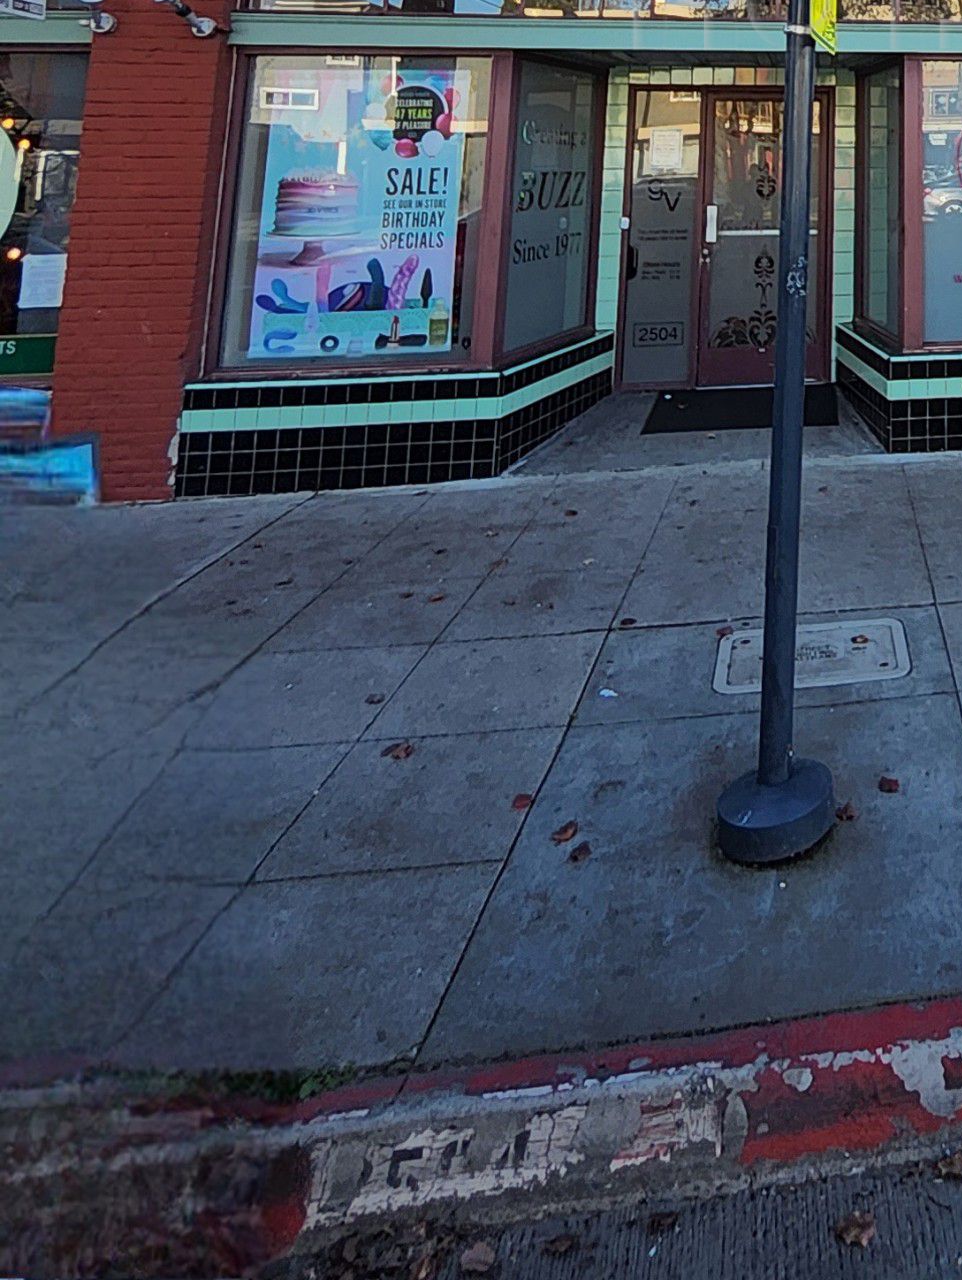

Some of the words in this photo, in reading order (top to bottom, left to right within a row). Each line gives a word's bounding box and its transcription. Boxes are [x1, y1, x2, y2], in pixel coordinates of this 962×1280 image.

[407, 108, 432, 119] YEARS
[386, 167, 448, 195] SALE!
[515, 171, 586, 213] BUZZ
[383, 200, 396, 209] SEE
[399, 200, 412, 208] OUR
[382, 211, 445, 228] BIRTHDAY
[380, 231, 444, 250] SPECIALS
[513, 239, 550, 265] Since
[555, 232, 582, 257] 1977
[638, 327, 678, 341] 2504
